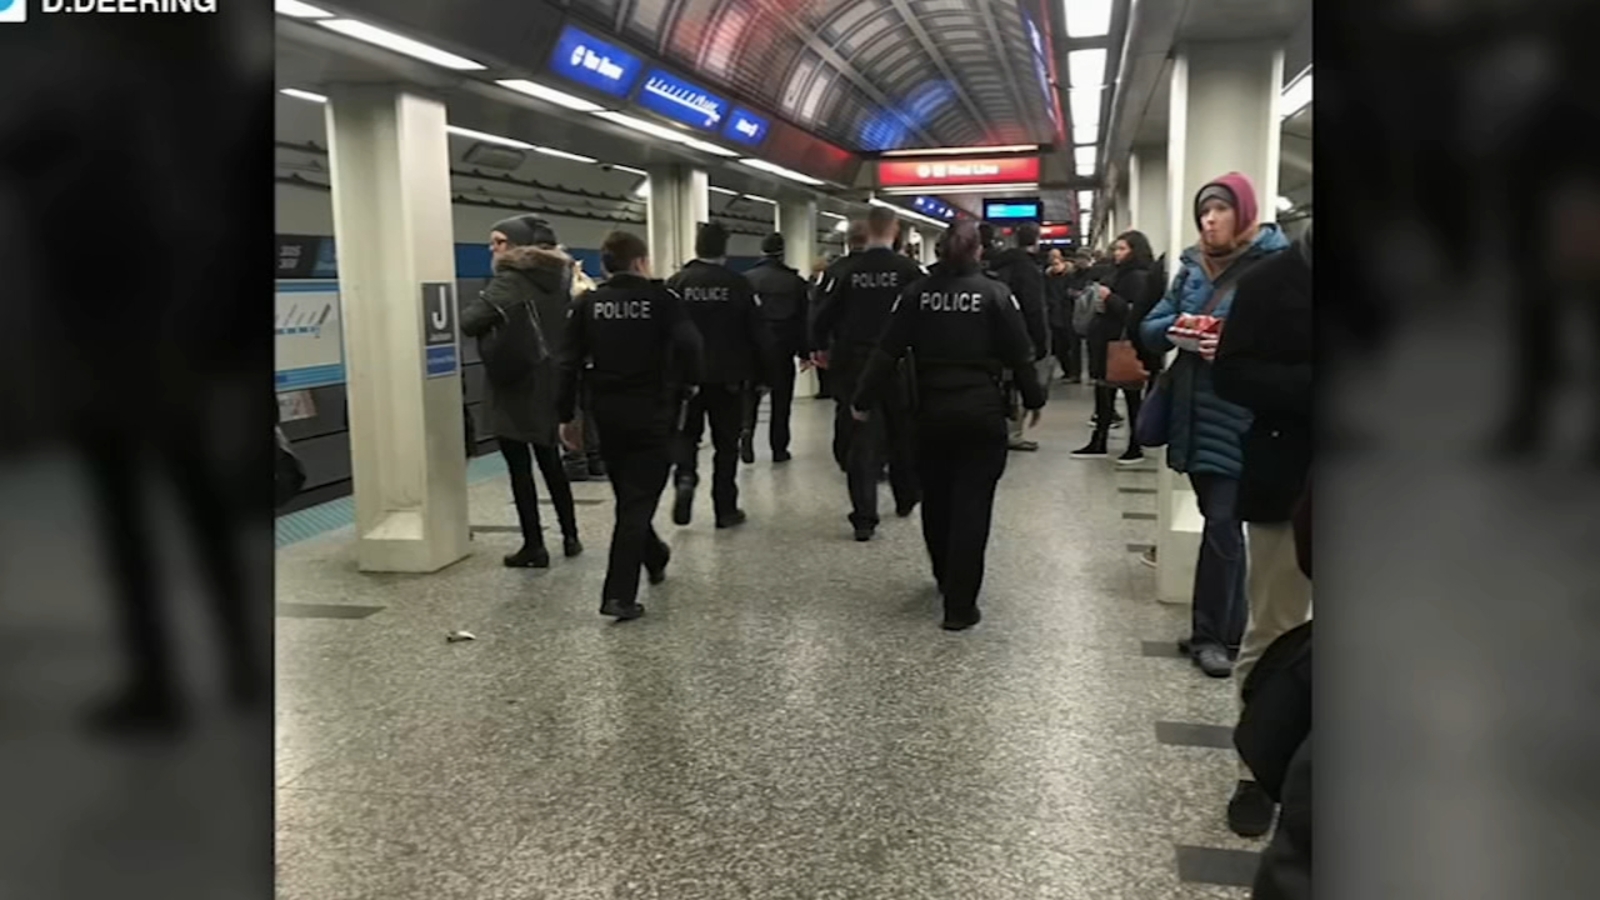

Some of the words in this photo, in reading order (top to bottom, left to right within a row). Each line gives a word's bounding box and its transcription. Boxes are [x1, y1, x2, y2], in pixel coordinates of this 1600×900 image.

[850, 271, 898, 288] POLICE
[684, 287, 730, 301] POLICE
[920, 291, 982, 312] POLICE
[431, 285, 448, 330] J
[593, 301, 651, 319] POLICE
